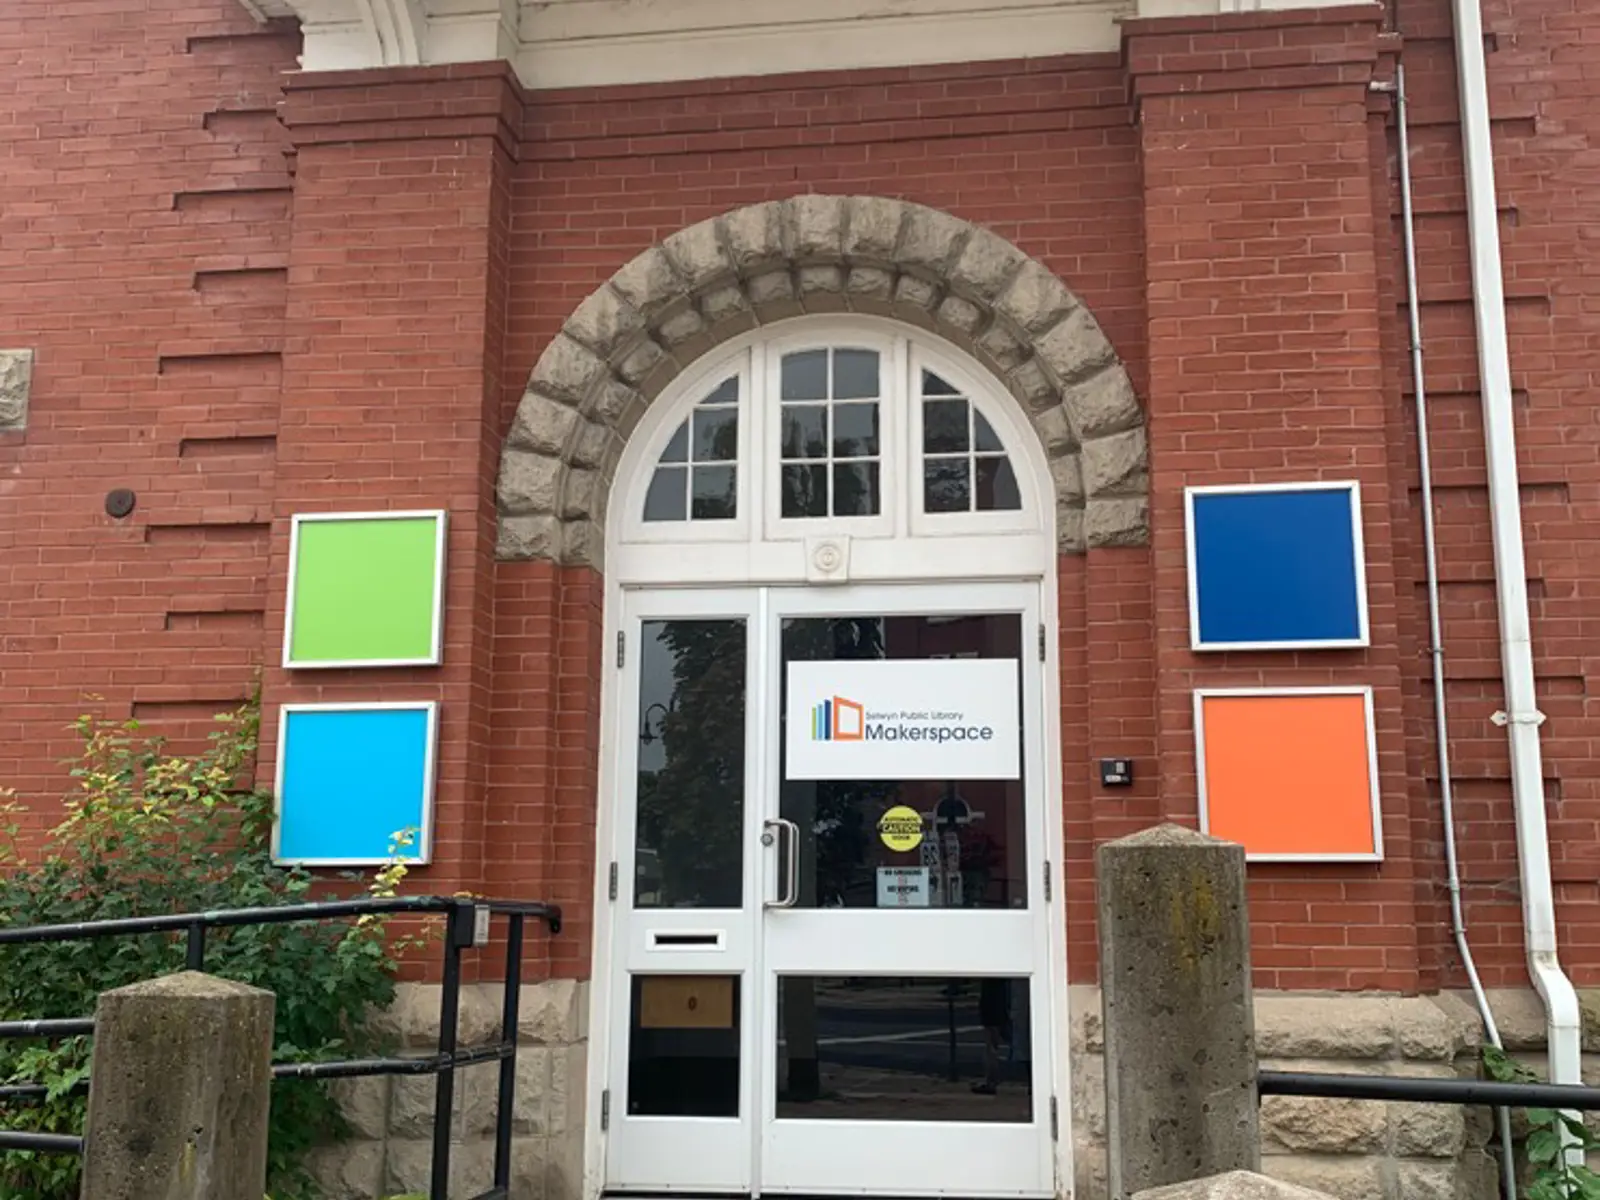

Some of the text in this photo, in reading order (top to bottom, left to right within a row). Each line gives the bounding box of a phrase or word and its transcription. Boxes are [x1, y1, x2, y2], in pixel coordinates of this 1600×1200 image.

[865, 711, 964, 721] Selwyn Public Library
[865, 723, 993, 744] Makerspace
[882, 823, 920, 833] CAUTION
